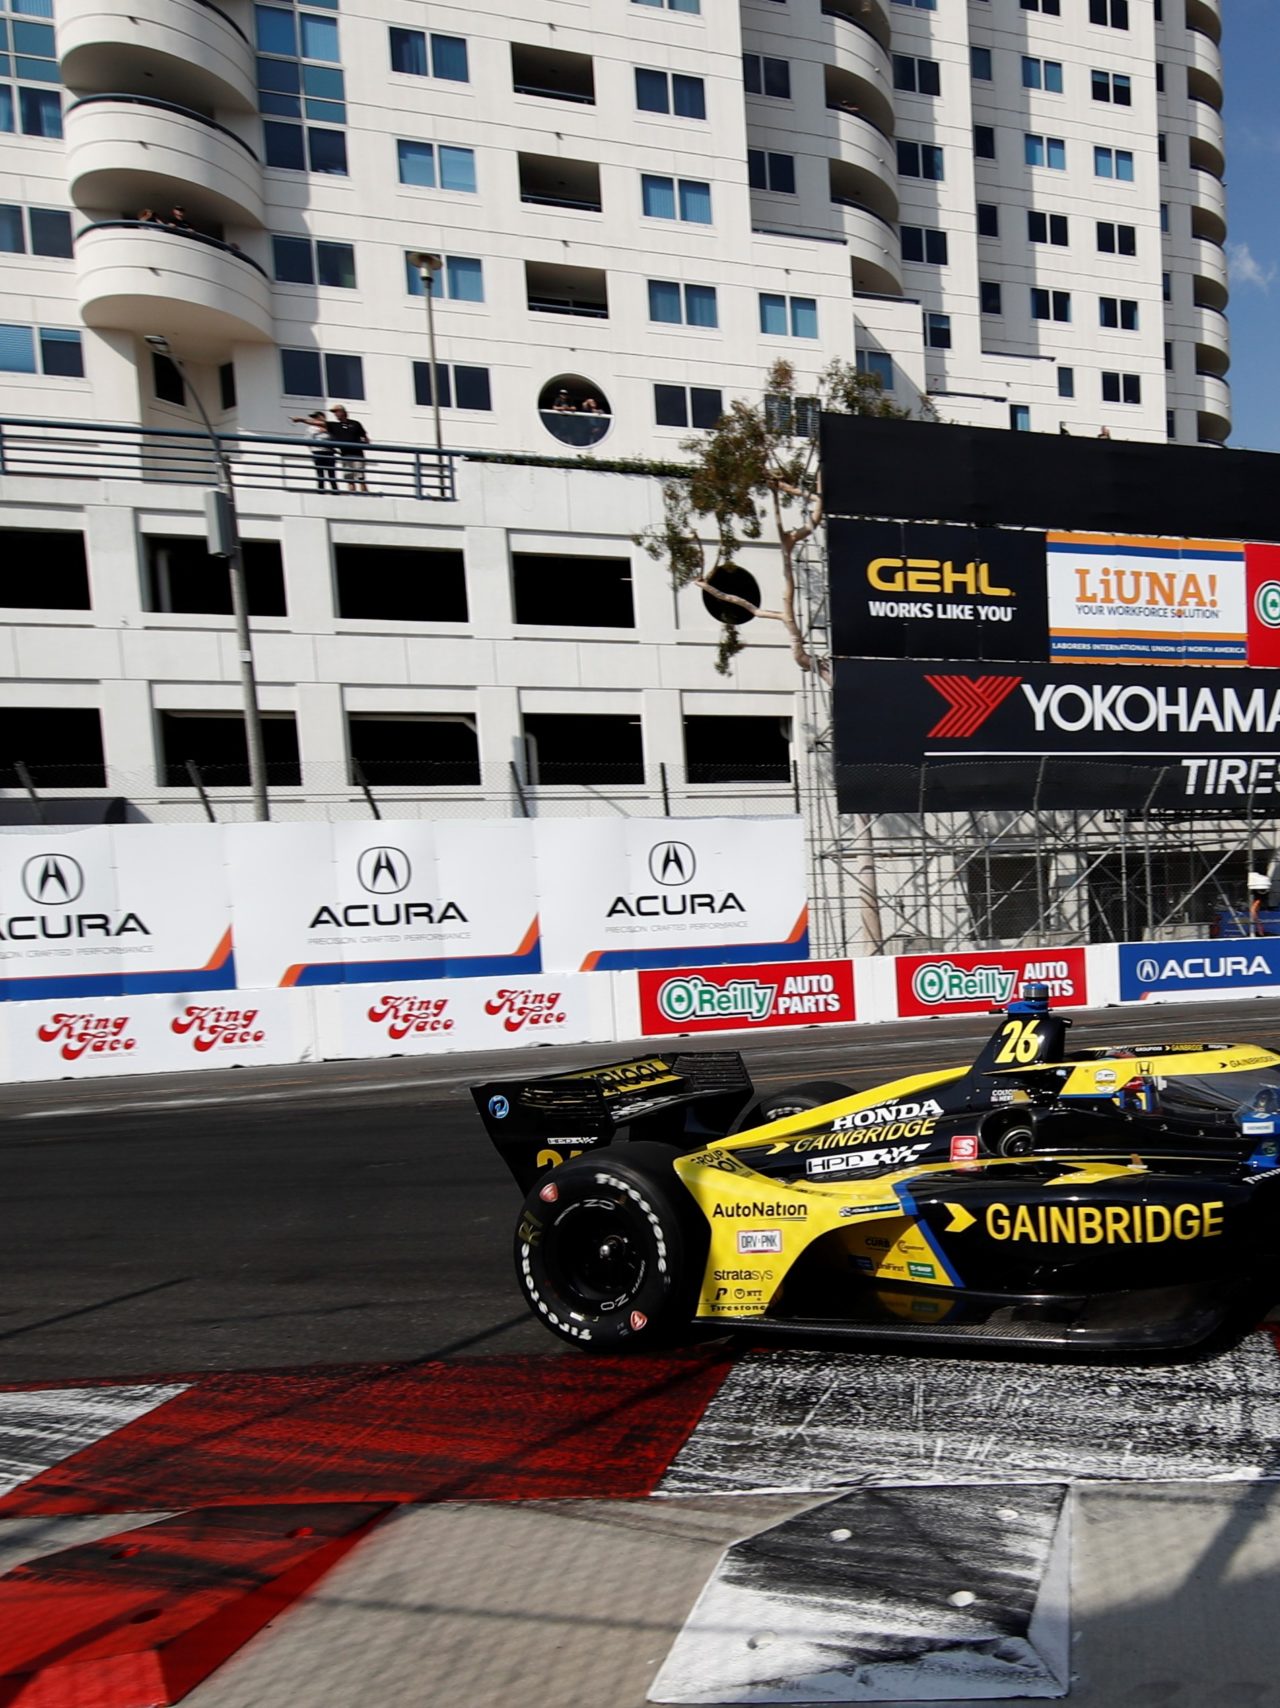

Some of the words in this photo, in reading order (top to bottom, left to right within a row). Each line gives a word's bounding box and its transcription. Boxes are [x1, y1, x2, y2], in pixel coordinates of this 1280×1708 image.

[867, 558, 1011, 596] GEHL
[1075, 567, 1217, 608] LiUNA!
[868, 601, 933, 618] WORKS
[937, 604, 974, 620] LIKE
[1076, 605, 1104, 616] YOUR
[1106, 606, 1168, 618] WORKFORCE
[1172, 608, 1219, 618] SOLUTION
[1052, 642, 1090, 650] LABORERS
[1092, 644, 1150, 652] INTERNATIONAL
[308, 902, 469, 928] ACURA
[606, 892, 746, 918] ACURA
[1024, 962, 1068, 981] AUTO
[1159, 955, 1272, 980] ACURA
[783, 974, 835, 994] AUTO
[915, 964, 1014, 1002] O'Reilly
[368, 996, 448, 1022] King
[485, 989, 561, 1015] King
[661, 976, 776, 1020] O'Reilly
[778, 992, 840, 1014] PARTS
[37, 1013, 130, 1042] King
[172, 1006, 258, 1034] King
[388, 1013, 454, 1040] Taco
[504, 1006, 566, 1032] Taco
[61, 1032, 136, 1060] Taco
[194, 1024, 264, 1052] Taco
[995, 1020, 1040, 1063] 26
[1230, 1056, 1276, 1068] GAINBRIDGE
[831, 1098, 944, 1132] HONDA
[794, 1117, 940, 1153] GAINBRIDGE
[807, 1154, 864, 1173] HPD
[712, 1202, 808, 1218] AutoNation
[986, 1201, 1224, 1244] GAINBRIDGE
[714, 1270, 774, 1282] stratasys
[710, 1304, 766, 1312] Firestone
